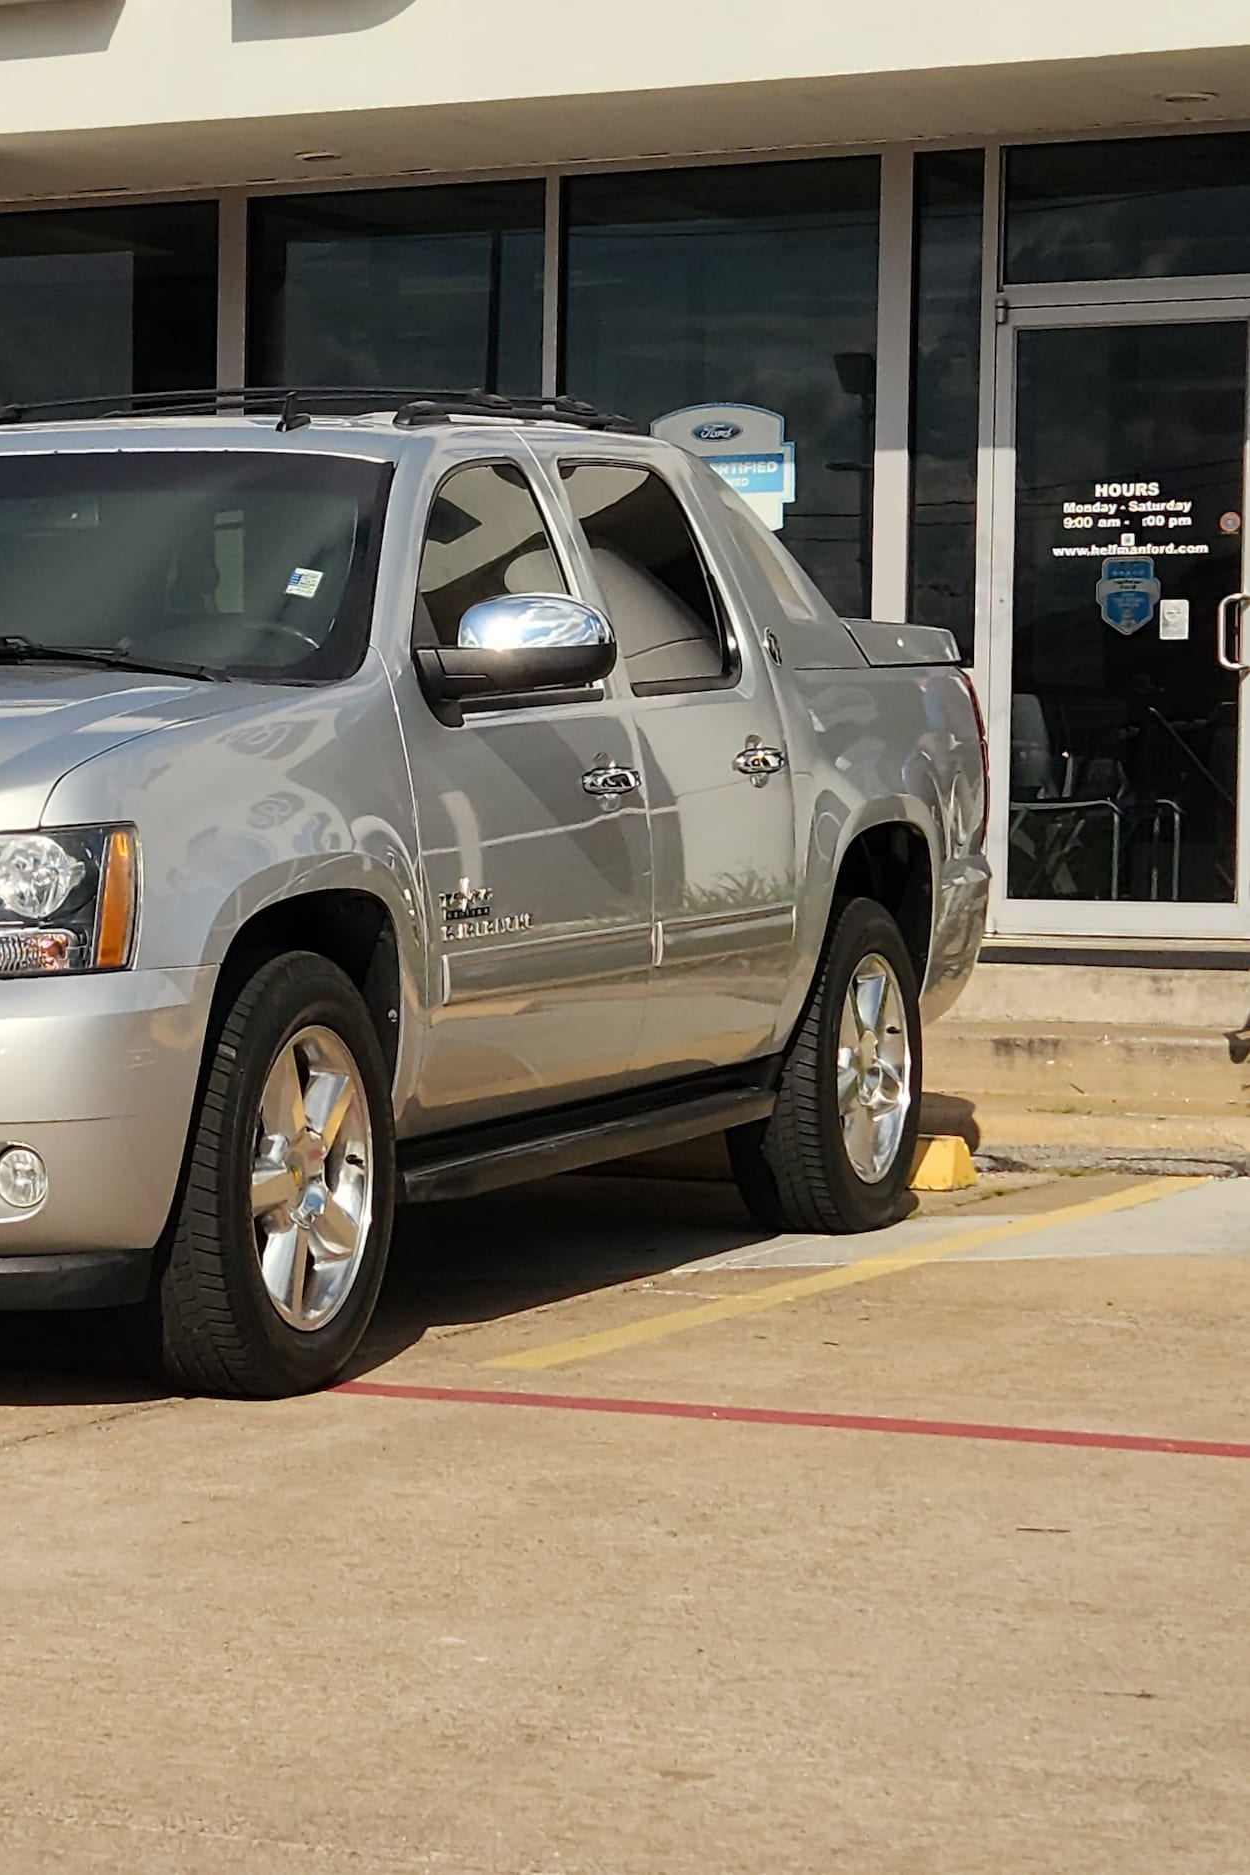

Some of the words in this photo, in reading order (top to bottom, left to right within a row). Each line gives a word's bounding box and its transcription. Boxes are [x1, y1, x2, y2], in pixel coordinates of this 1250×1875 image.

[701, 423, 734, 439] Ford
[716, 461, 778, 474] RTIFIED
[1094, 482, 1160, 498] HOURS
[1063, 501, 1117, 515] Monday
[1128, 499, 1192, 513] Saturday
[1063, 516, 1093, 529] 9:00
[1097, 518, 1121, 528] am
[1168, 516, 1192, 528] pm
[1052, 542, 1209, 557] www.helfmanford.com
